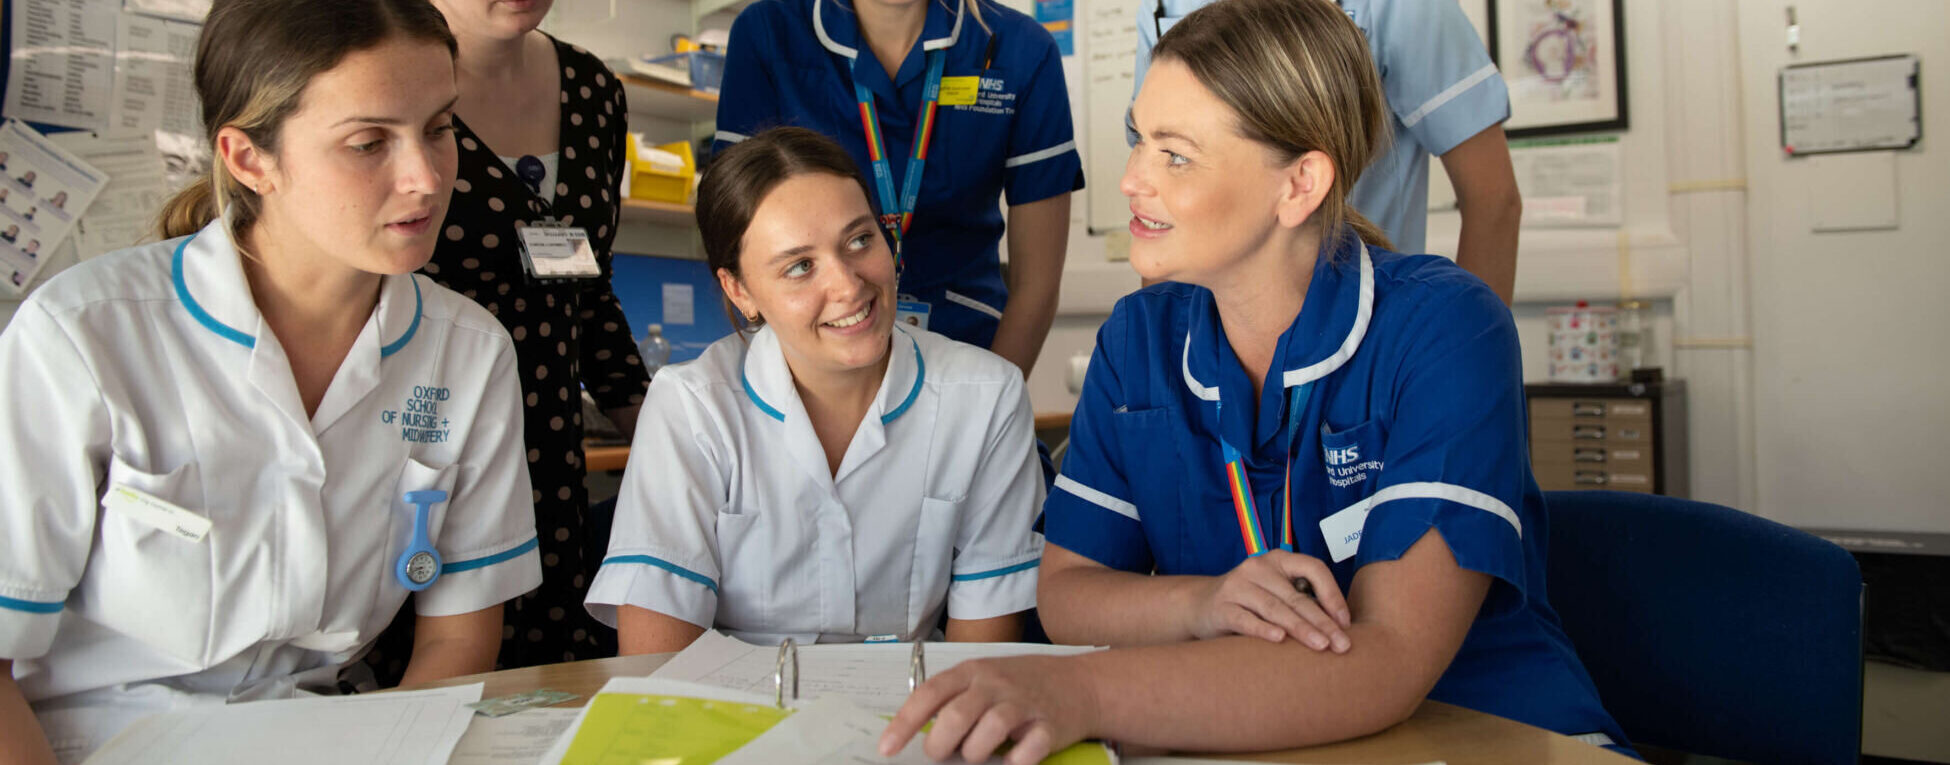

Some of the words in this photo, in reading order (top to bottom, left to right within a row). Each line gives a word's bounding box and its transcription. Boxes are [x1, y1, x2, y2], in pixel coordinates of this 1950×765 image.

[979, 78, 1004, 91] NHS
[968, 105, 1004, 114] Foundation
[382, 410, 397, 424] OF
[1324, 446, 1359, 465] NHS
[1338, 460, 1385, 477] University
